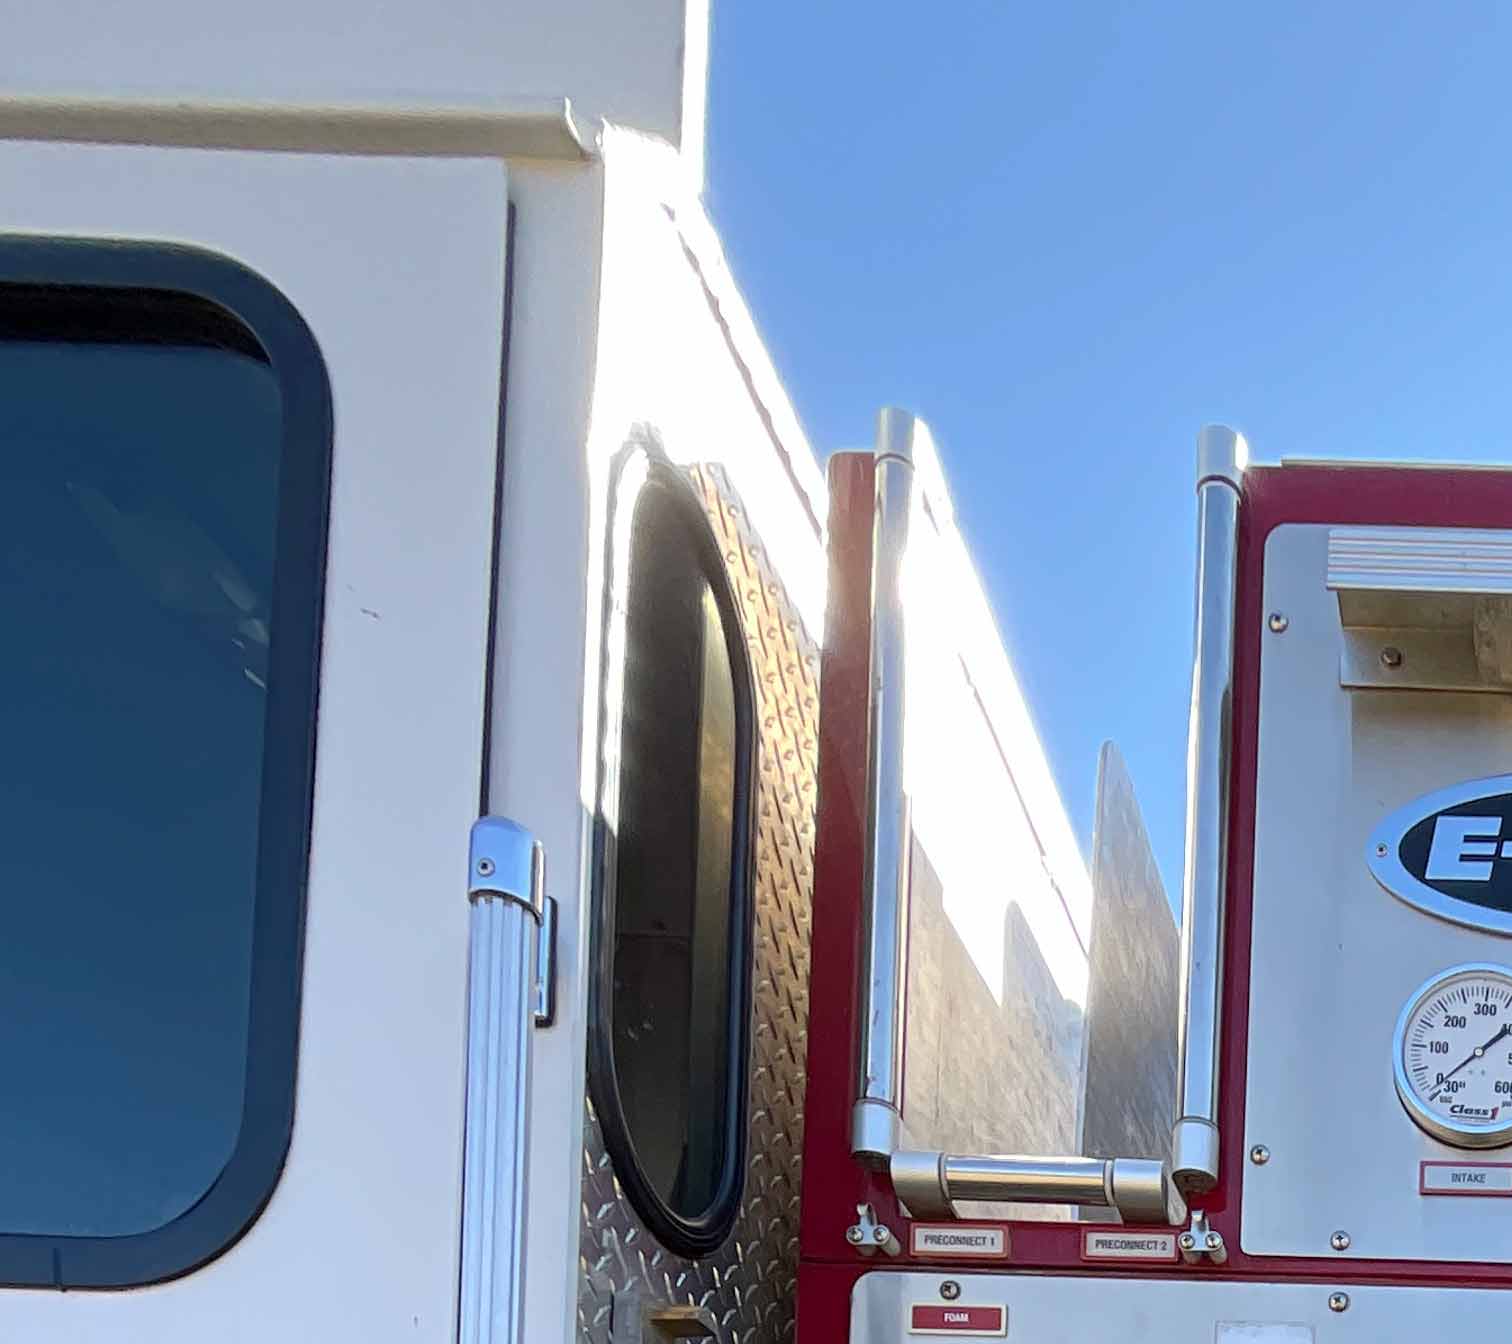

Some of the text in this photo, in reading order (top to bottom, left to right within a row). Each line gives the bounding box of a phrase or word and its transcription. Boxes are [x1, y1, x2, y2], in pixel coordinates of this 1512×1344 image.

[1474, 1003, 1497, 1016] 300
[1444, 1015, 1466, 1028] 200
[1430, 1041, 1449, 1054] 100
[1452, 1171, 1486, 1185] INTAKE
[924, 1234, 987, 1247] PRECONNECT
[1095, 1239, 1168, 1251] PRECONNECT 2
[944, 1312, 969, 1323] FOAM
